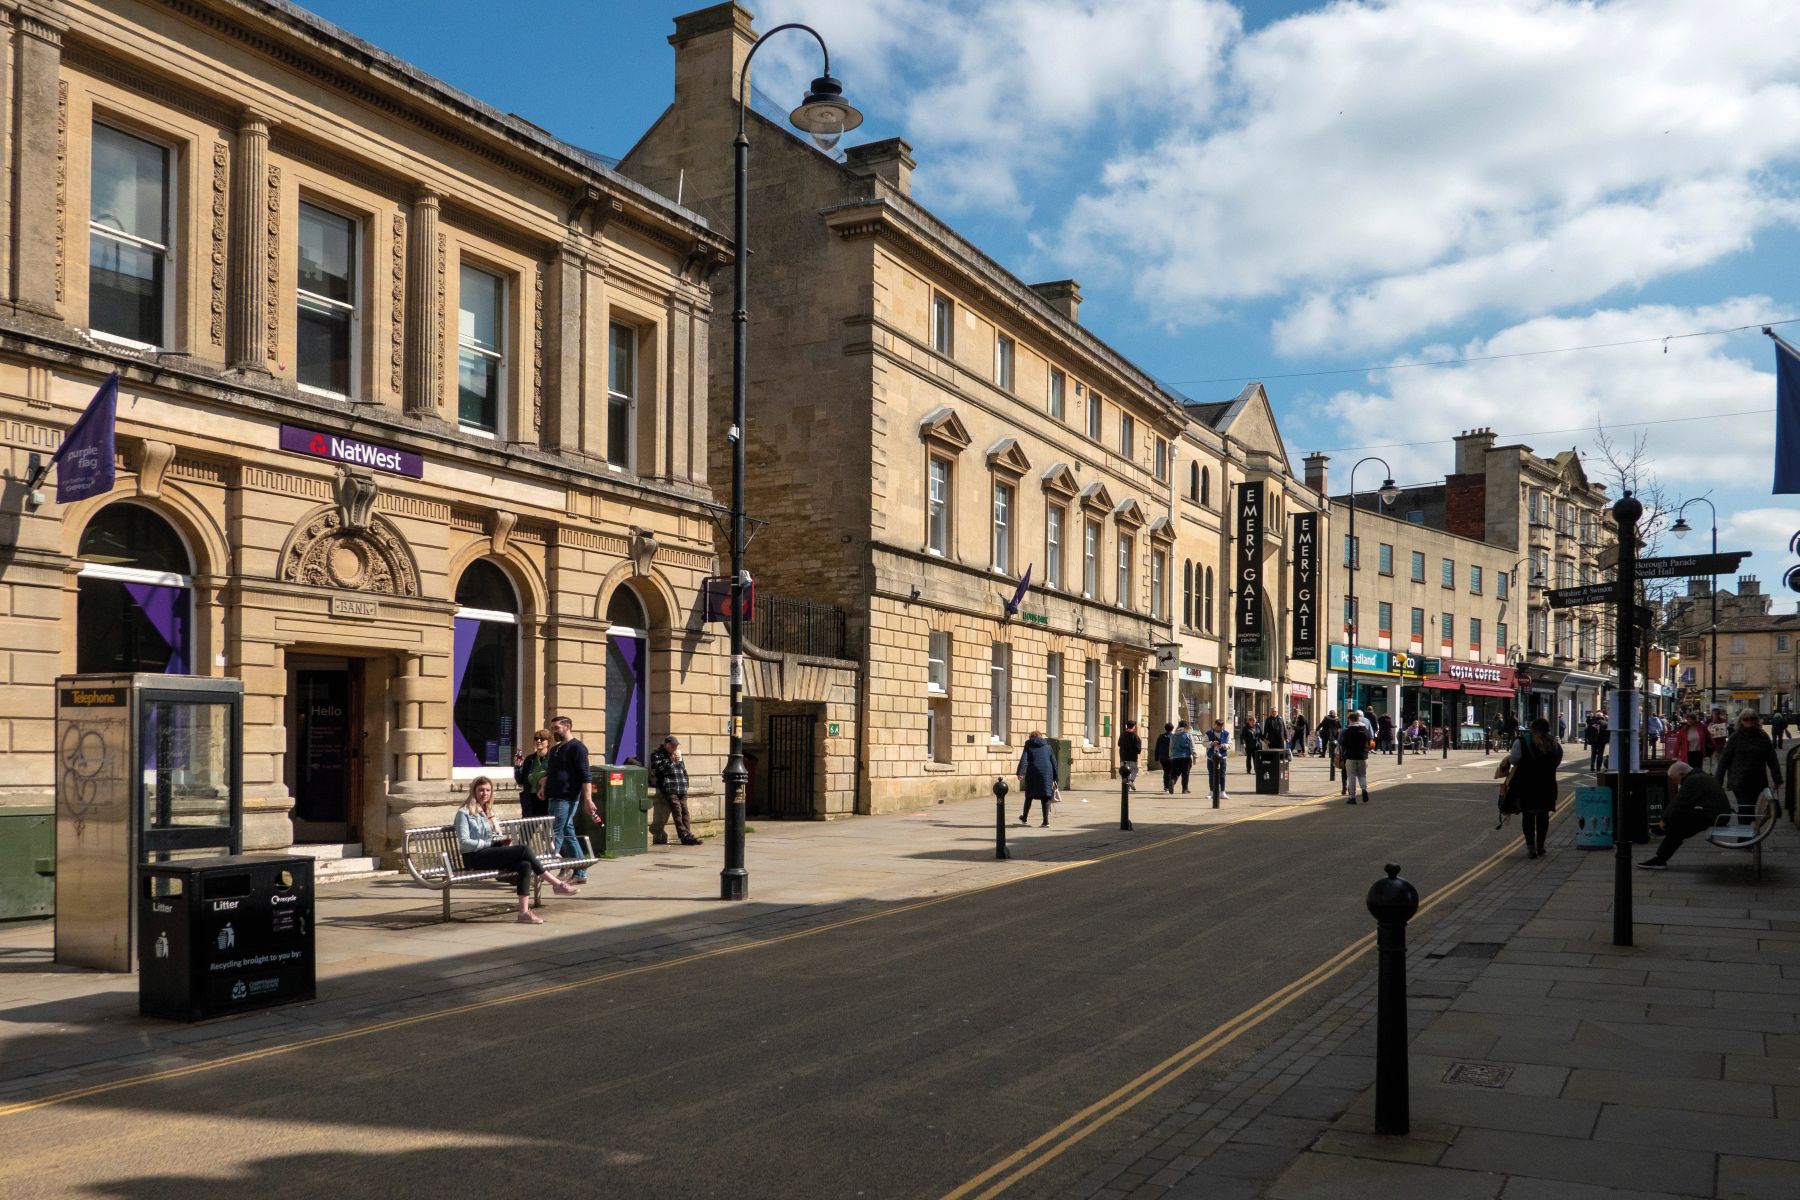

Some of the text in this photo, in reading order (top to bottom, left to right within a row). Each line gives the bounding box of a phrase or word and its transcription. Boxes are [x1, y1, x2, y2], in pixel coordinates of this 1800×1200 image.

[68, 444, 98, 461] purple
[331, 437, 402, 471] NatWest
[79, 458, 98, 469] flag
[1243, 489, 1258, 625] EMERY GATE
[1635, 558, 1696, 569] Borough Parade
[1634, 567, 1674, 577] Neeld Hall
[1298, 519, 1312, 640] EMERY GATE
[1558, 589, 1581, 598] Wiltshire
[1589, 586, 1613, 594] Swindon
[1566, 597, 1584, 605] History
[340, 600, 370, 616] BANK
[1450, 664, 1473, 679] COSTA
[1475, 667, 1501, 682] COFFEE
[72, 690, 115, 706] Telephone
[311, 705, 342, 716] Hello
[279, 894, 297, 903] recycle
[152, 902, 173, 913] Litter
[213, 900, 240, 911] Litter
[210, 950, 302, 971] Recycling brought to you by:
